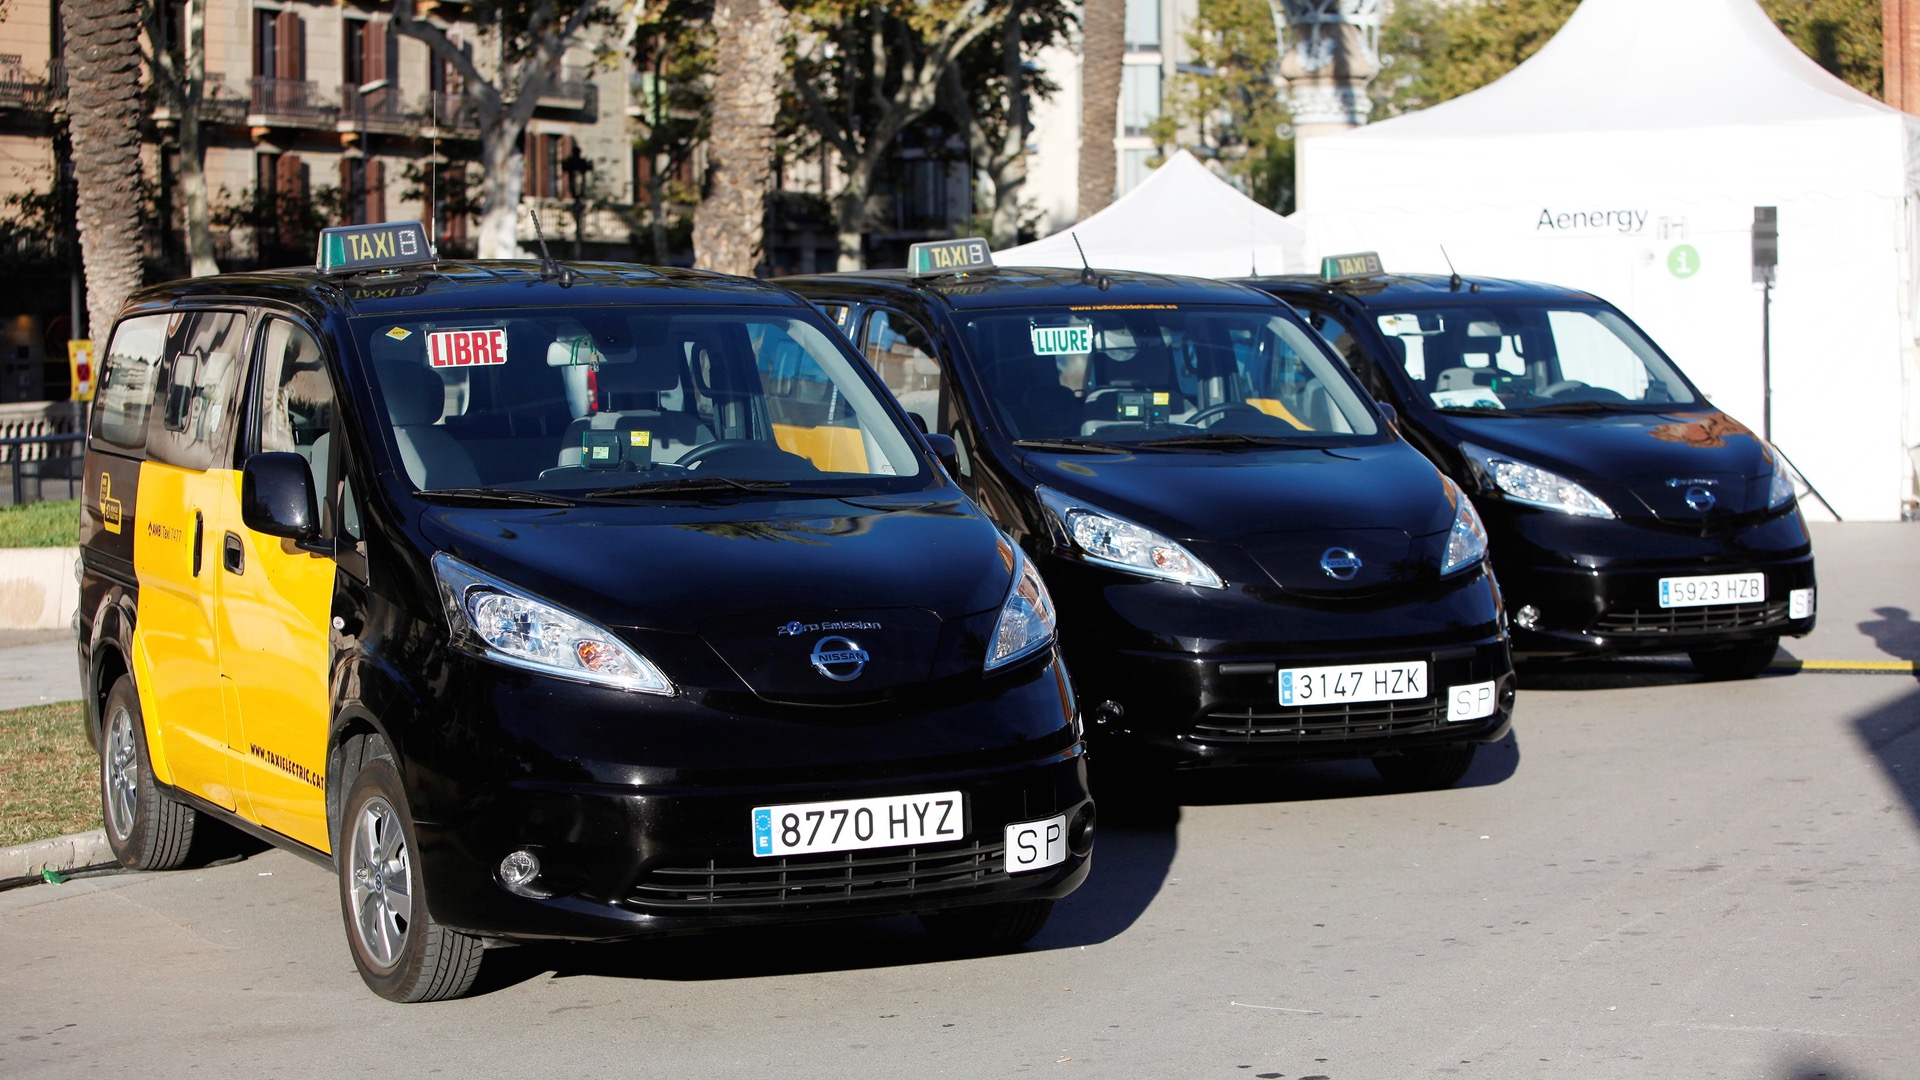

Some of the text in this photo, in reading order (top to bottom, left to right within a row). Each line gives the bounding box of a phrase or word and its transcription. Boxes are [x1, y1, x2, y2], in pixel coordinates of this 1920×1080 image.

[1536, 207, 1648, 233] Aenergy
[347, 231, 396, 261] TAXI
[931, 245, 969, 269] TAXI
[1338, 256, 1368, 276] TAXI
[431, 331, 504, 367] LIBRE
[1037, 329, 1088, 352] LLIURE
[1674, 578, 1760, 602] 5923 HZB
[821, 621, 882, 631] Emission
[818, 652, 865, 662] NISSAN
[1300, 671, 1363, 699] 3147
[1374, 667, 1419, 695] HZK
[1456, 687, 1490, 715] SP
[782, 808, 873, 848] 8770
[889, 800, 954, 840] HYZ
[1017, 823, 1060, 864] SP
